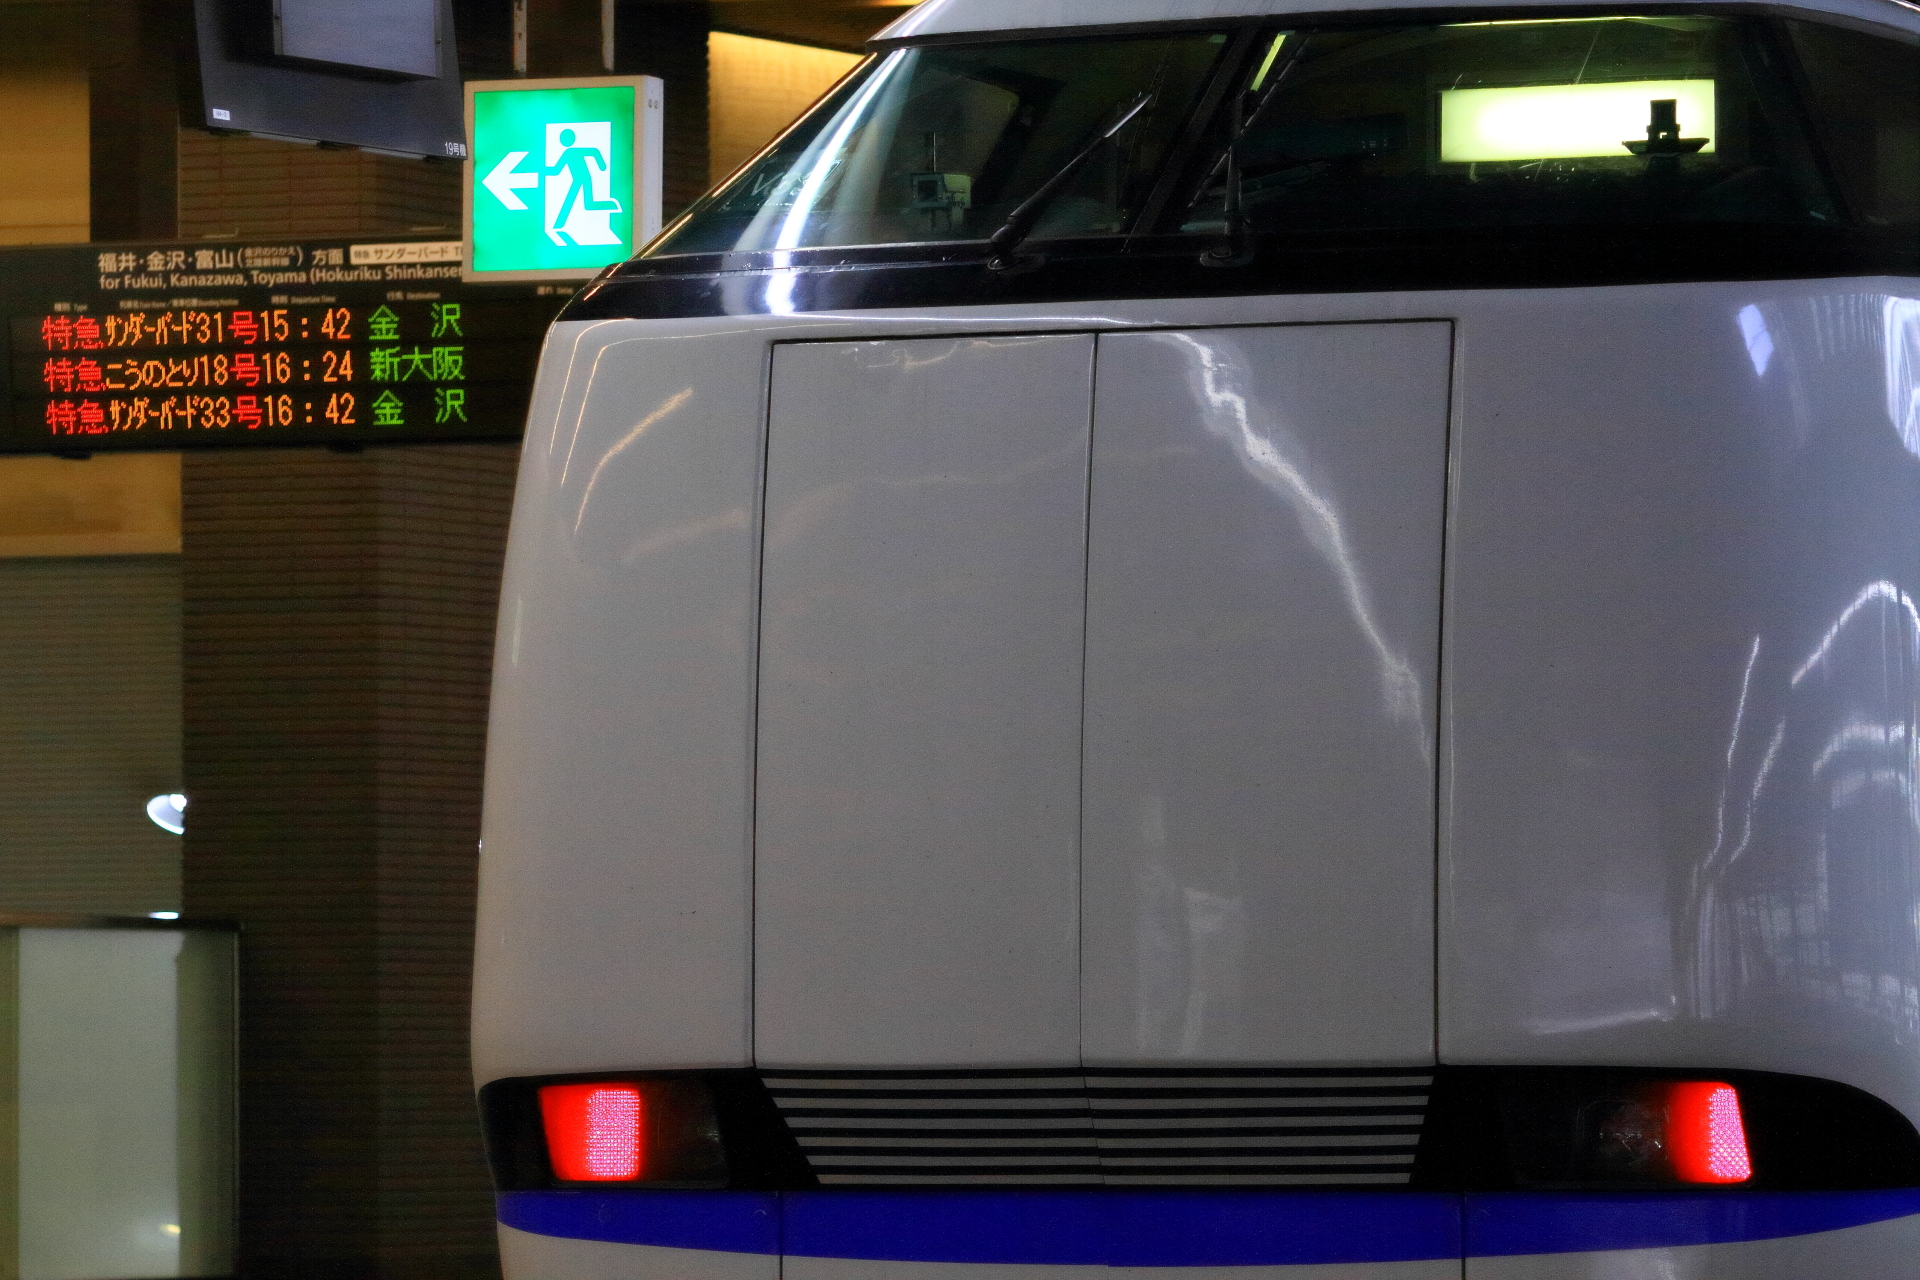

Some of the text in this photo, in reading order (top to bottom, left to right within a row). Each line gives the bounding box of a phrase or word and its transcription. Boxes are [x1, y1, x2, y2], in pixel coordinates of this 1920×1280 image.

[445, 141, 467, 157] 19号機
[312, 248, 343, 265] 方面
[374, 246, 449, 261] サンダーバード
[100, 275, 120, 290] for
[124, 273, 167, 290] Fukui,
[170, 272, 247, 287] Kanazawa,
[251, 269, 306, 287] Toyama
[310, 266, 382, 285] (Hokuriku
[42, 315, 104, 350] 特急
[44, 357, 106, 393] 特急
[370, 346, 465, 382] 新大阪
[47, 399, 109, 435] 特急
